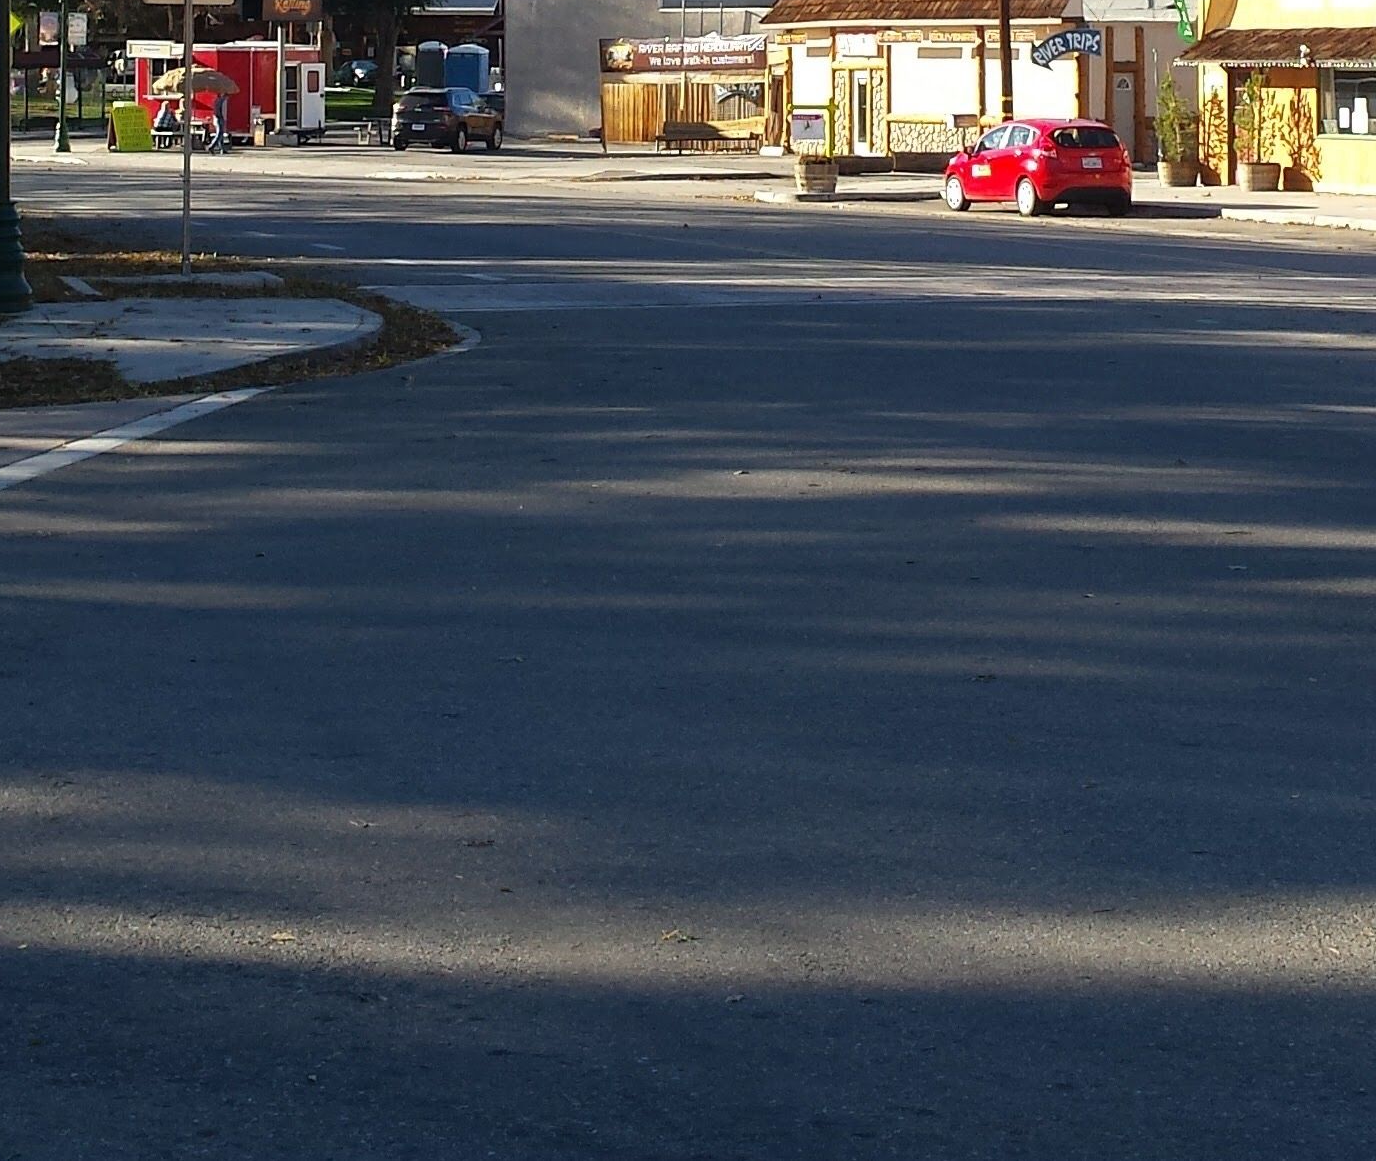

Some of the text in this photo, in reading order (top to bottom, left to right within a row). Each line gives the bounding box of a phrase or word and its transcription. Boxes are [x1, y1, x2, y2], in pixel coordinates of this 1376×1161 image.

[638, 43, 664, 54] RIVER
[1032, 37, 1067, 66] RIVER
[1067, 32, 1101, 53] TRIPS
[649, 57, 662, 67] We
